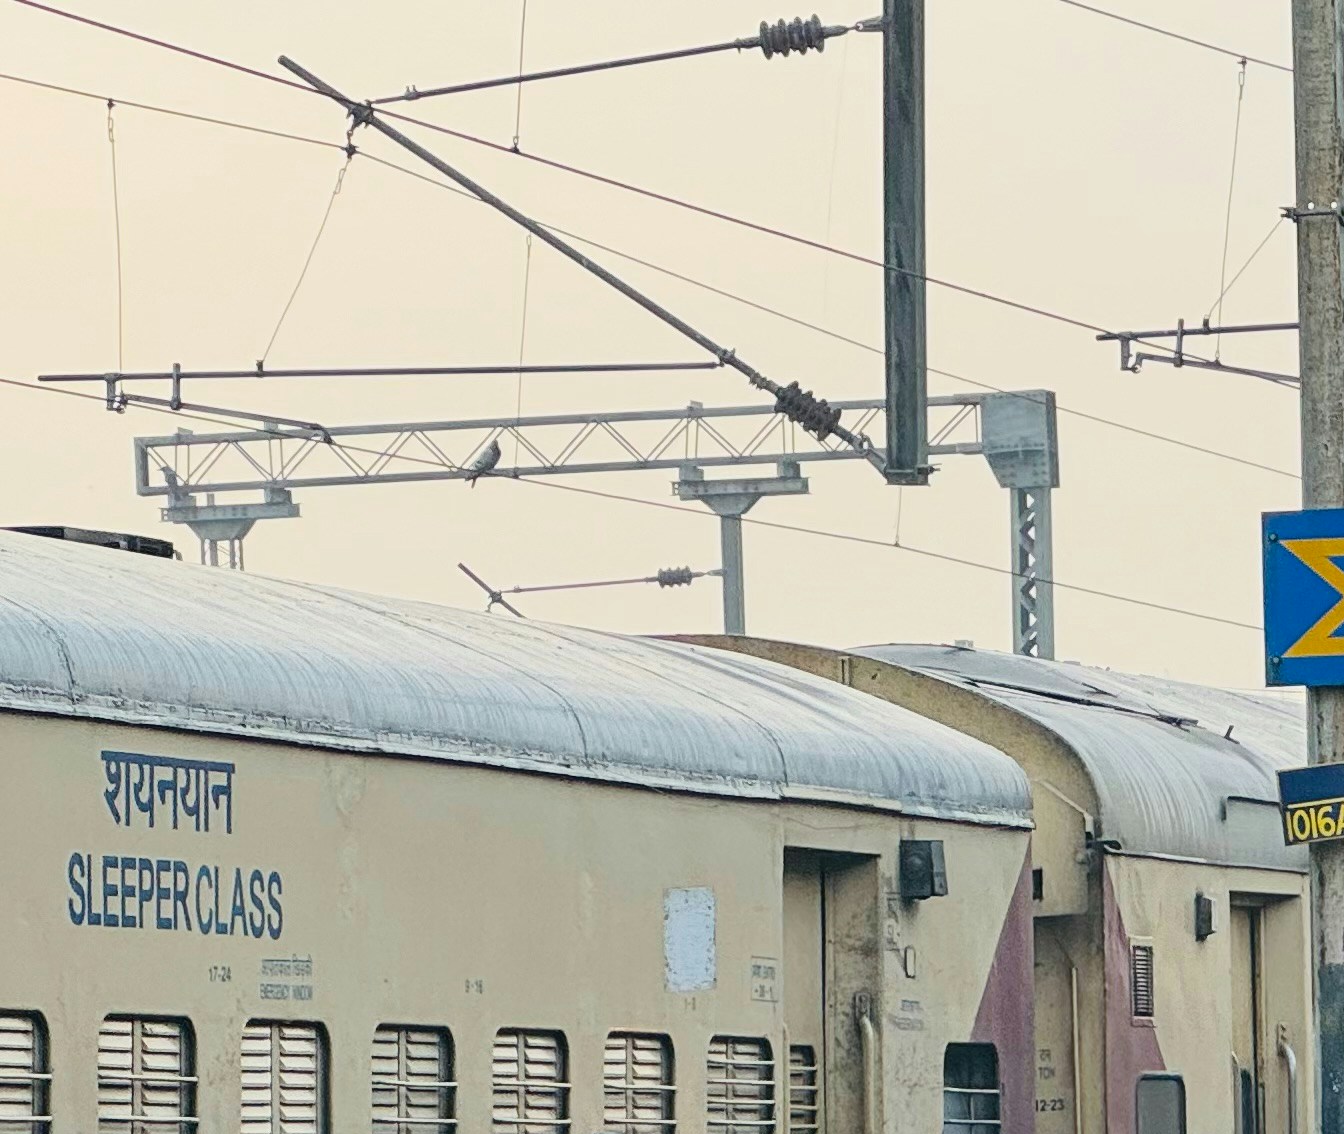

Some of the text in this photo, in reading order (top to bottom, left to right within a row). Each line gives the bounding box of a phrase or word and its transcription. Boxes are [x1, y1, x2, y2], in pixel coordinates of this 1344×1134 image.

[101, 750, 236, 834] शयनयान
[68, 852, 283, 940] SLEEPER CLASS
[208, 965, 232, 982] 17-24
